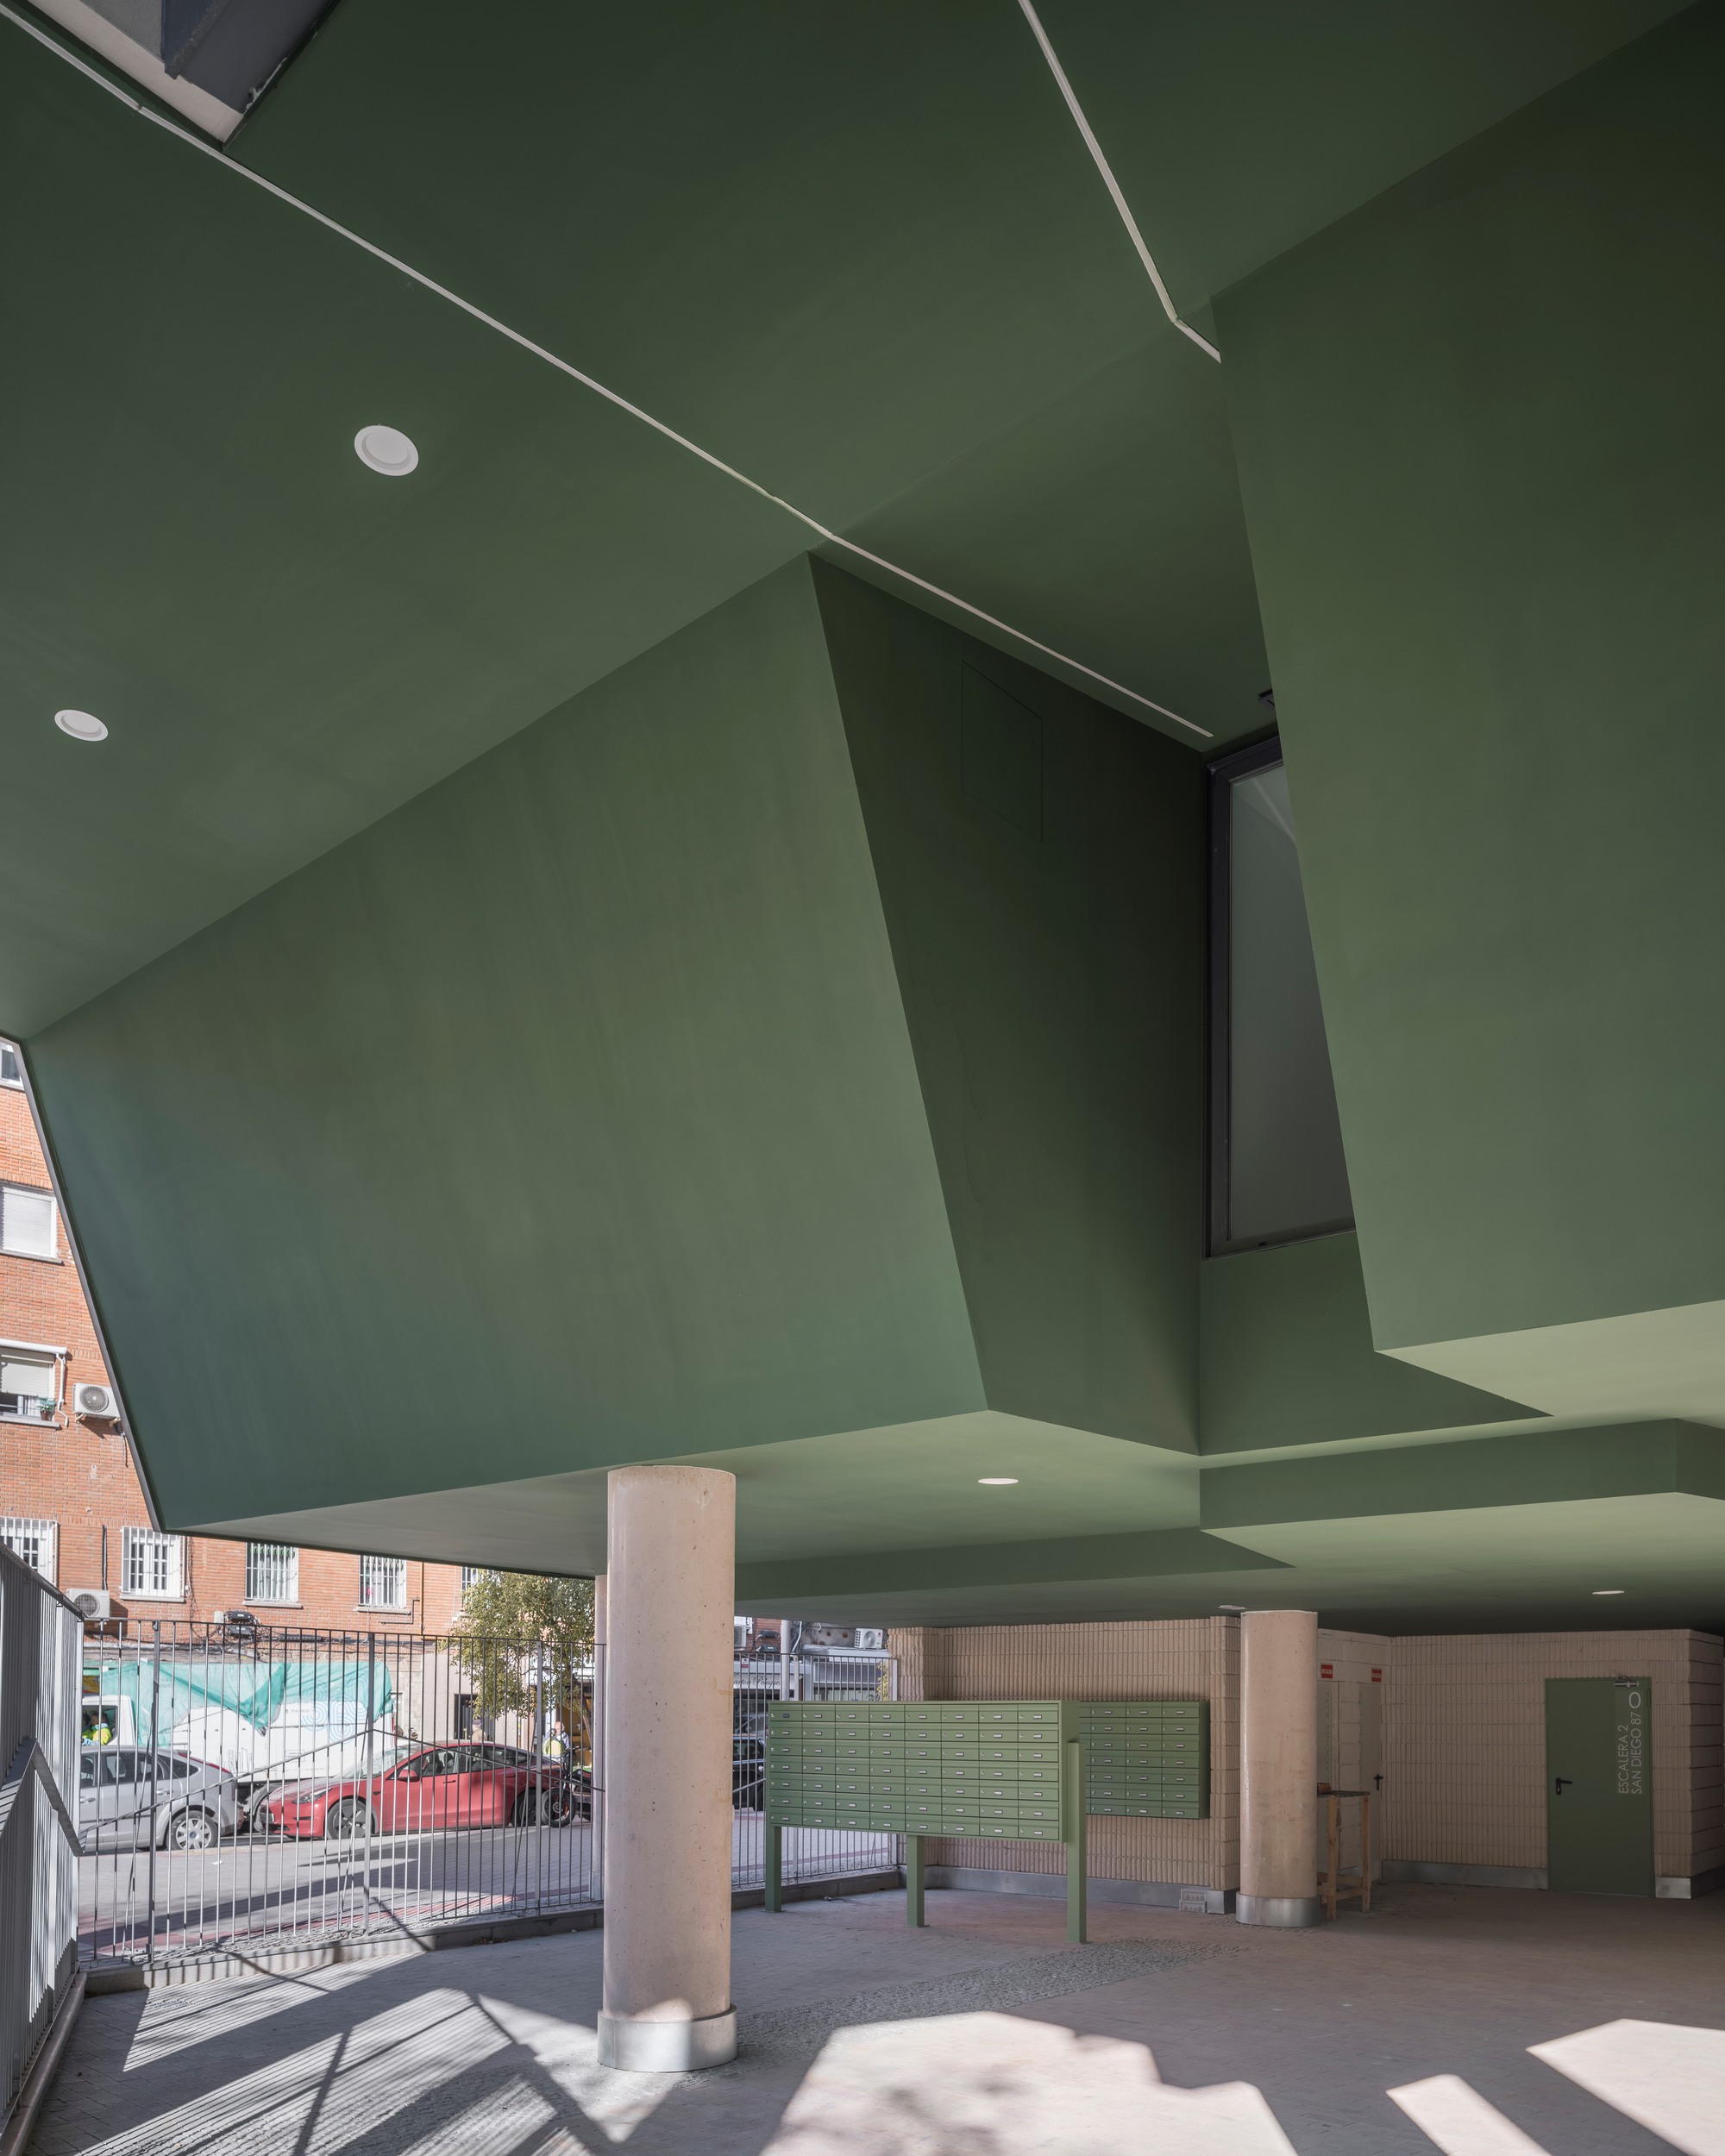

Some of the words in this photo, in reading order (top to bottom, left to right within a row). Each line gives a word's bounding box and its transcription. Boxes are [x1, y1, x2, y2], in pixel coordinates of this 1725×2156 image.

[1630, 1712, 1641, 1725] 87
[1630, 1727, 1642, 1767] DIEGO
[1618, 1734, 1629, 1794] ESCALERA
[1631, 1771, 1642, 1795] SAN
